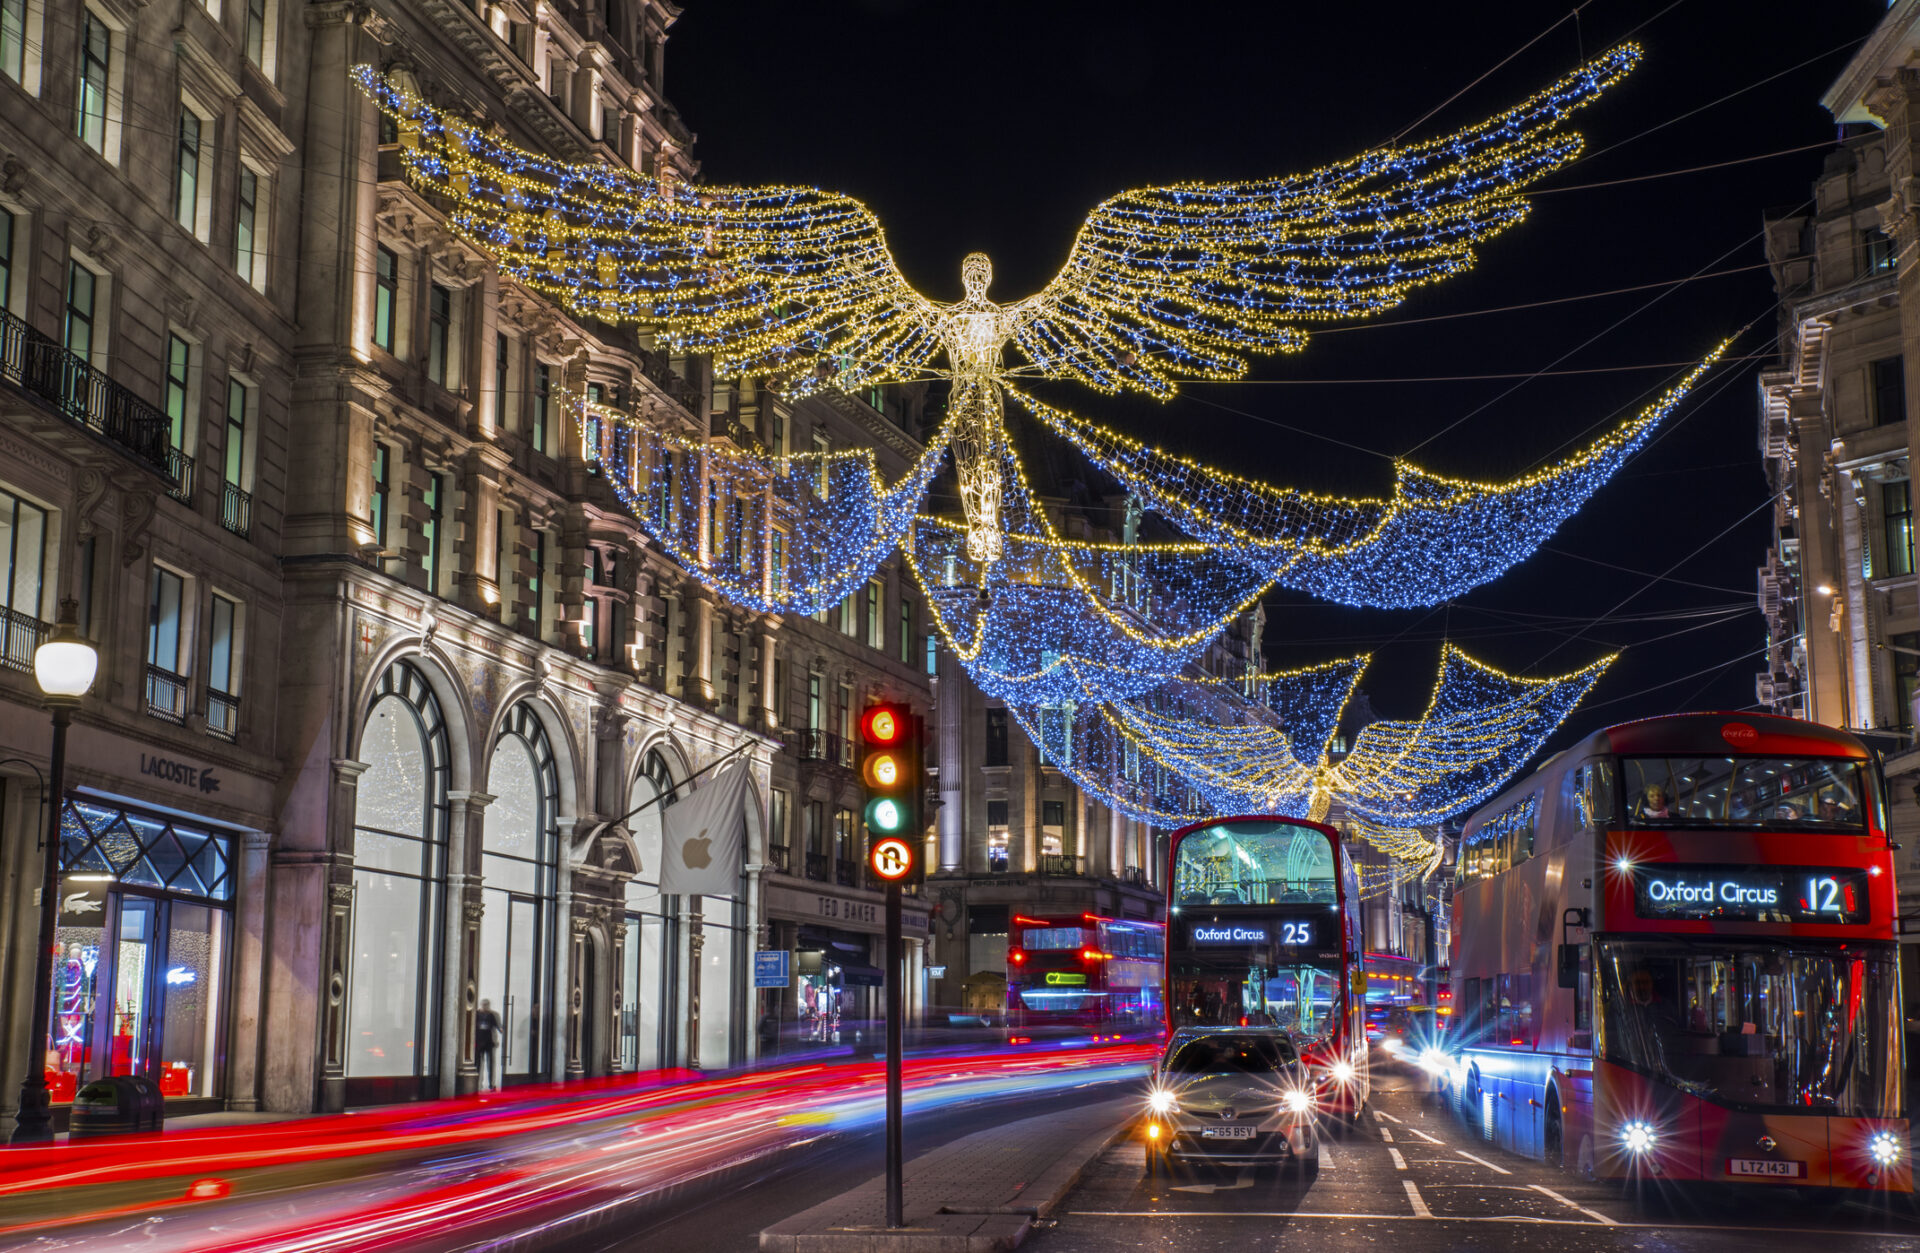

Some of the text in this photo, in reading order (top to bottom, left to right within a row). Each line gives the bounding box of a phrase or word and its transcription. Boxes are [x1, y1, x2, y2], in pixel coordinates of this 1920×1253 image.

[141, 753, 197, 787] LACOSTE
[1650, 877, 1840, 911] Oxford Circus 12
[818, 897, 876, 922] TED BAKER
[1195, 923, 1310, 944] Oxford Circus 25
[1045, 972, 1061, 984] C2
[1234, 1127, 1253, 1137] BSV
[1740, 1160, 1790, 1174] LTZ 1431
